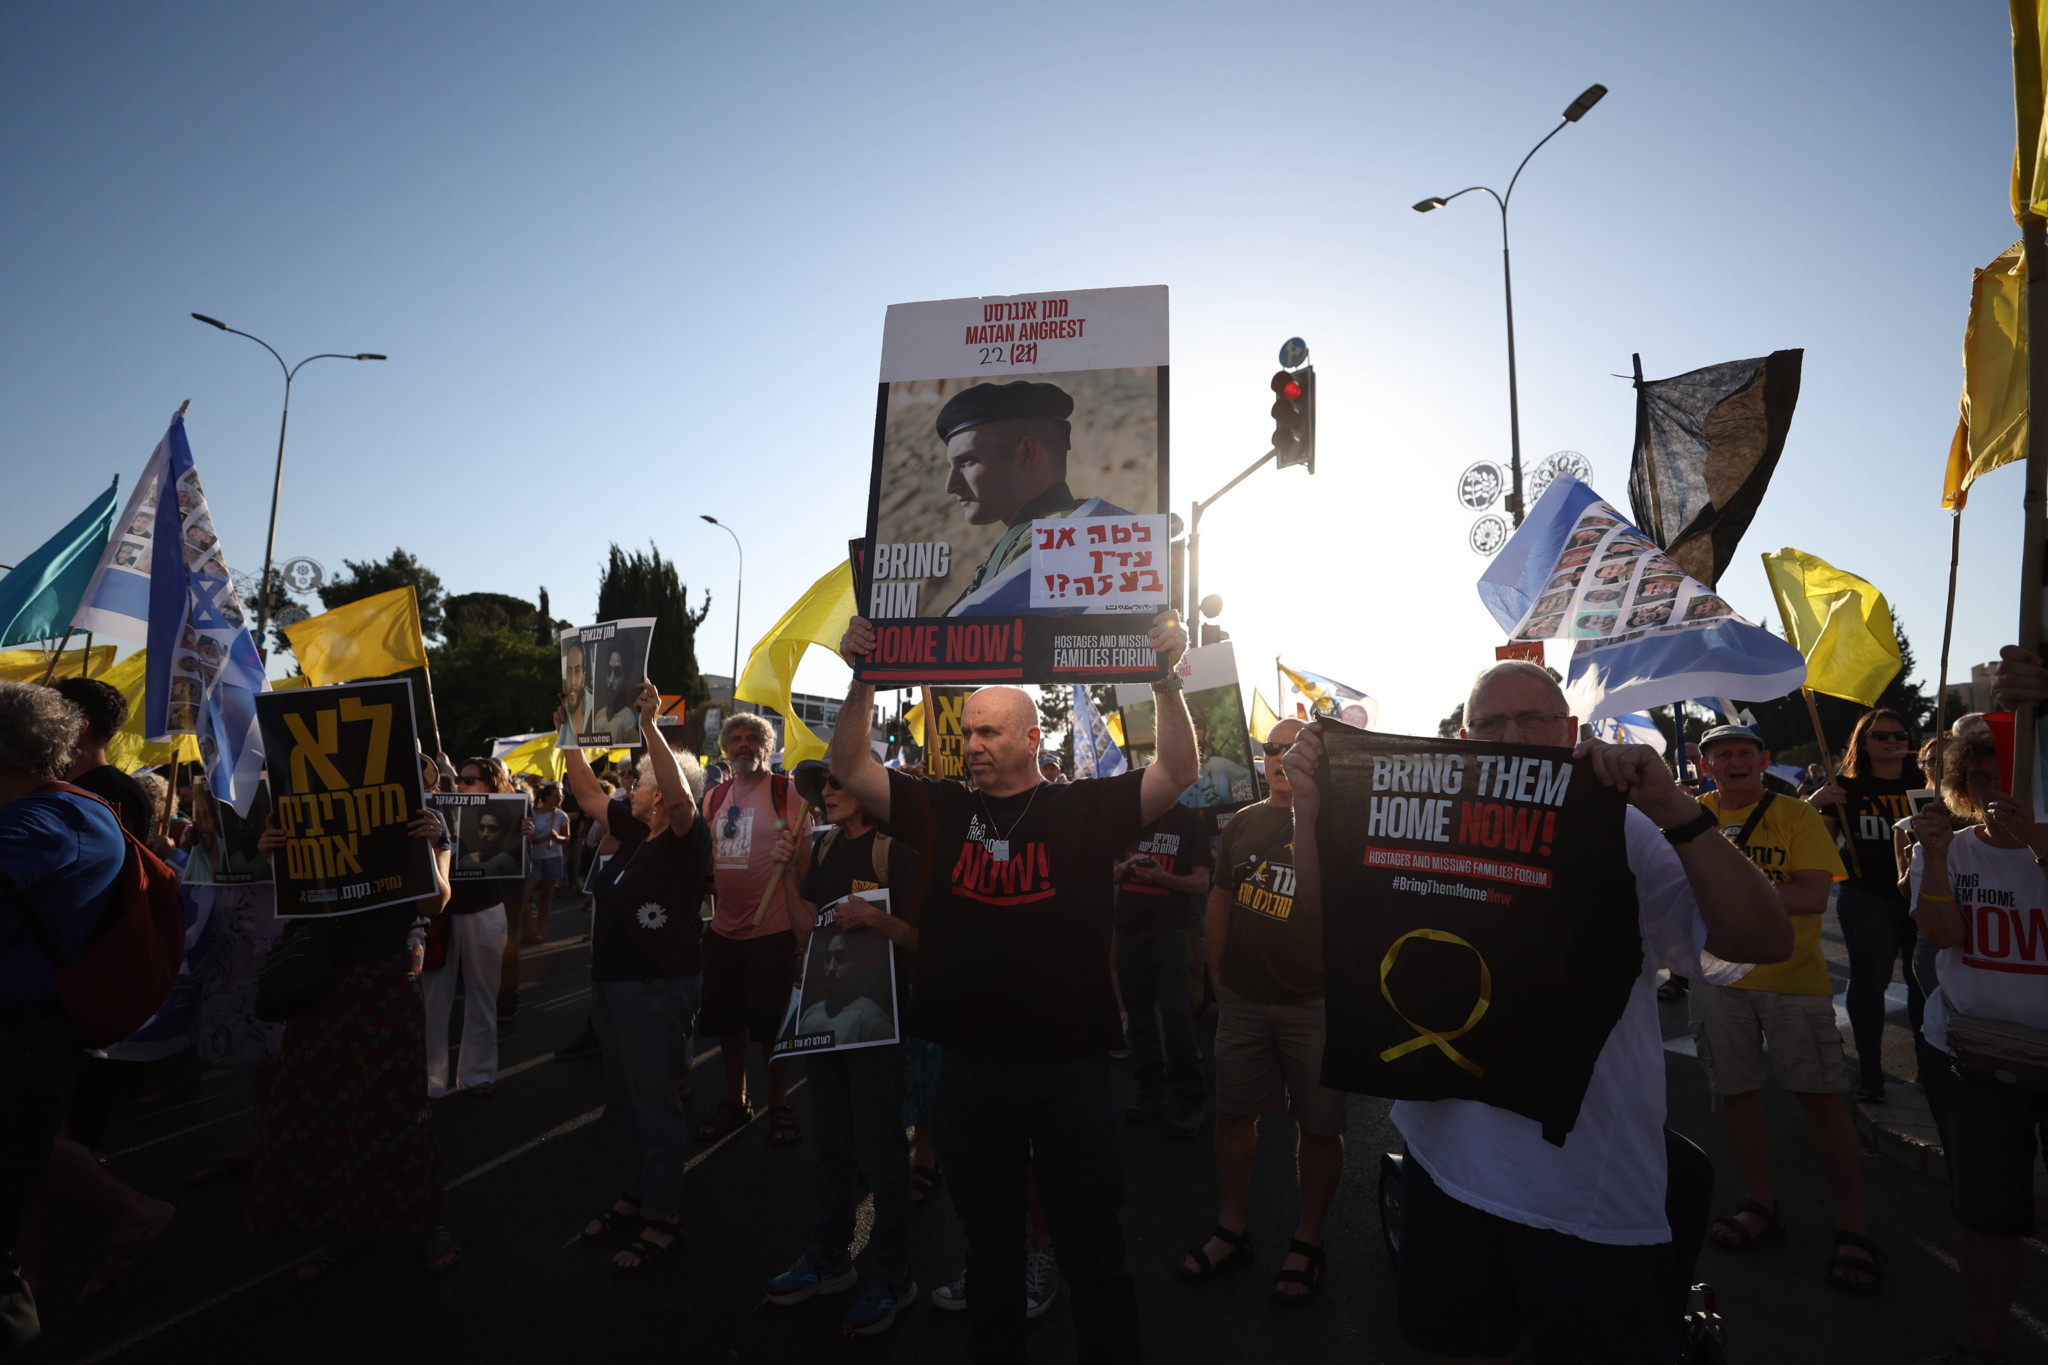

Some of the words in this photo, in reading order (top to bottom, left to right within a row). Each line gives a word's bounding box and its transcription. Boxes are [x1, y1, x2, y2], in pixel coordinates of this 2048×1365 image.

[984, 301, 1037, 322] אנגרסט
[1042, 299, 1068, 320] מתן
[966, 323, 1015, 344] MATAN
[1019, 319, 1086, 341] ANGREST
[979, 347, 1007, 365] 22
[1010, 342, 1038, 366] (21)
[1036, 527, 1077, 550] אני
[1087, 522, 1152, 545] למה
[873, 541, 950, 580] BRING
[869, 582, 919, 619] HIM
[865, 625, 939, 663] HOME
[945, 618, 1025, 663] NOW!
[1054, 635, 1098, 648] HOSTAGES
[1100, 635, 1116, 648] AND
[1118, 634, 1150, 648] MISSIN
[1054, 648, 1109, 668] FAMILIES
[1112, 647, 1157, 667] FORUM
[283, 697, 393, 793] לא
[1372, 753, 1465, 795] BRING
[1476, 755, 1573, 807] THEM
[278, 783, 408, 838] מקריבים
[470, 795, 486, 806] מתן
[1368, 796, 1453, 842] HOME
[1458, 800, 1559, 857] NOW!
[286, 832, 364, 880] אותם
[952, 842, 1051, 894] NOW!
[1369, 851, 1411, 867] HOSTAGES
[1412, 853, 1430, 869] AND
[1432, 857, 1471, 873] MISSING
[1473, 861, 1513, 879] FAMILIES
[1514, 868, 1548, 885] FORUM
[1392, 876, 1512, 906] #BringThemHomeNow
[1977, 889, 2016, 908] HOME
